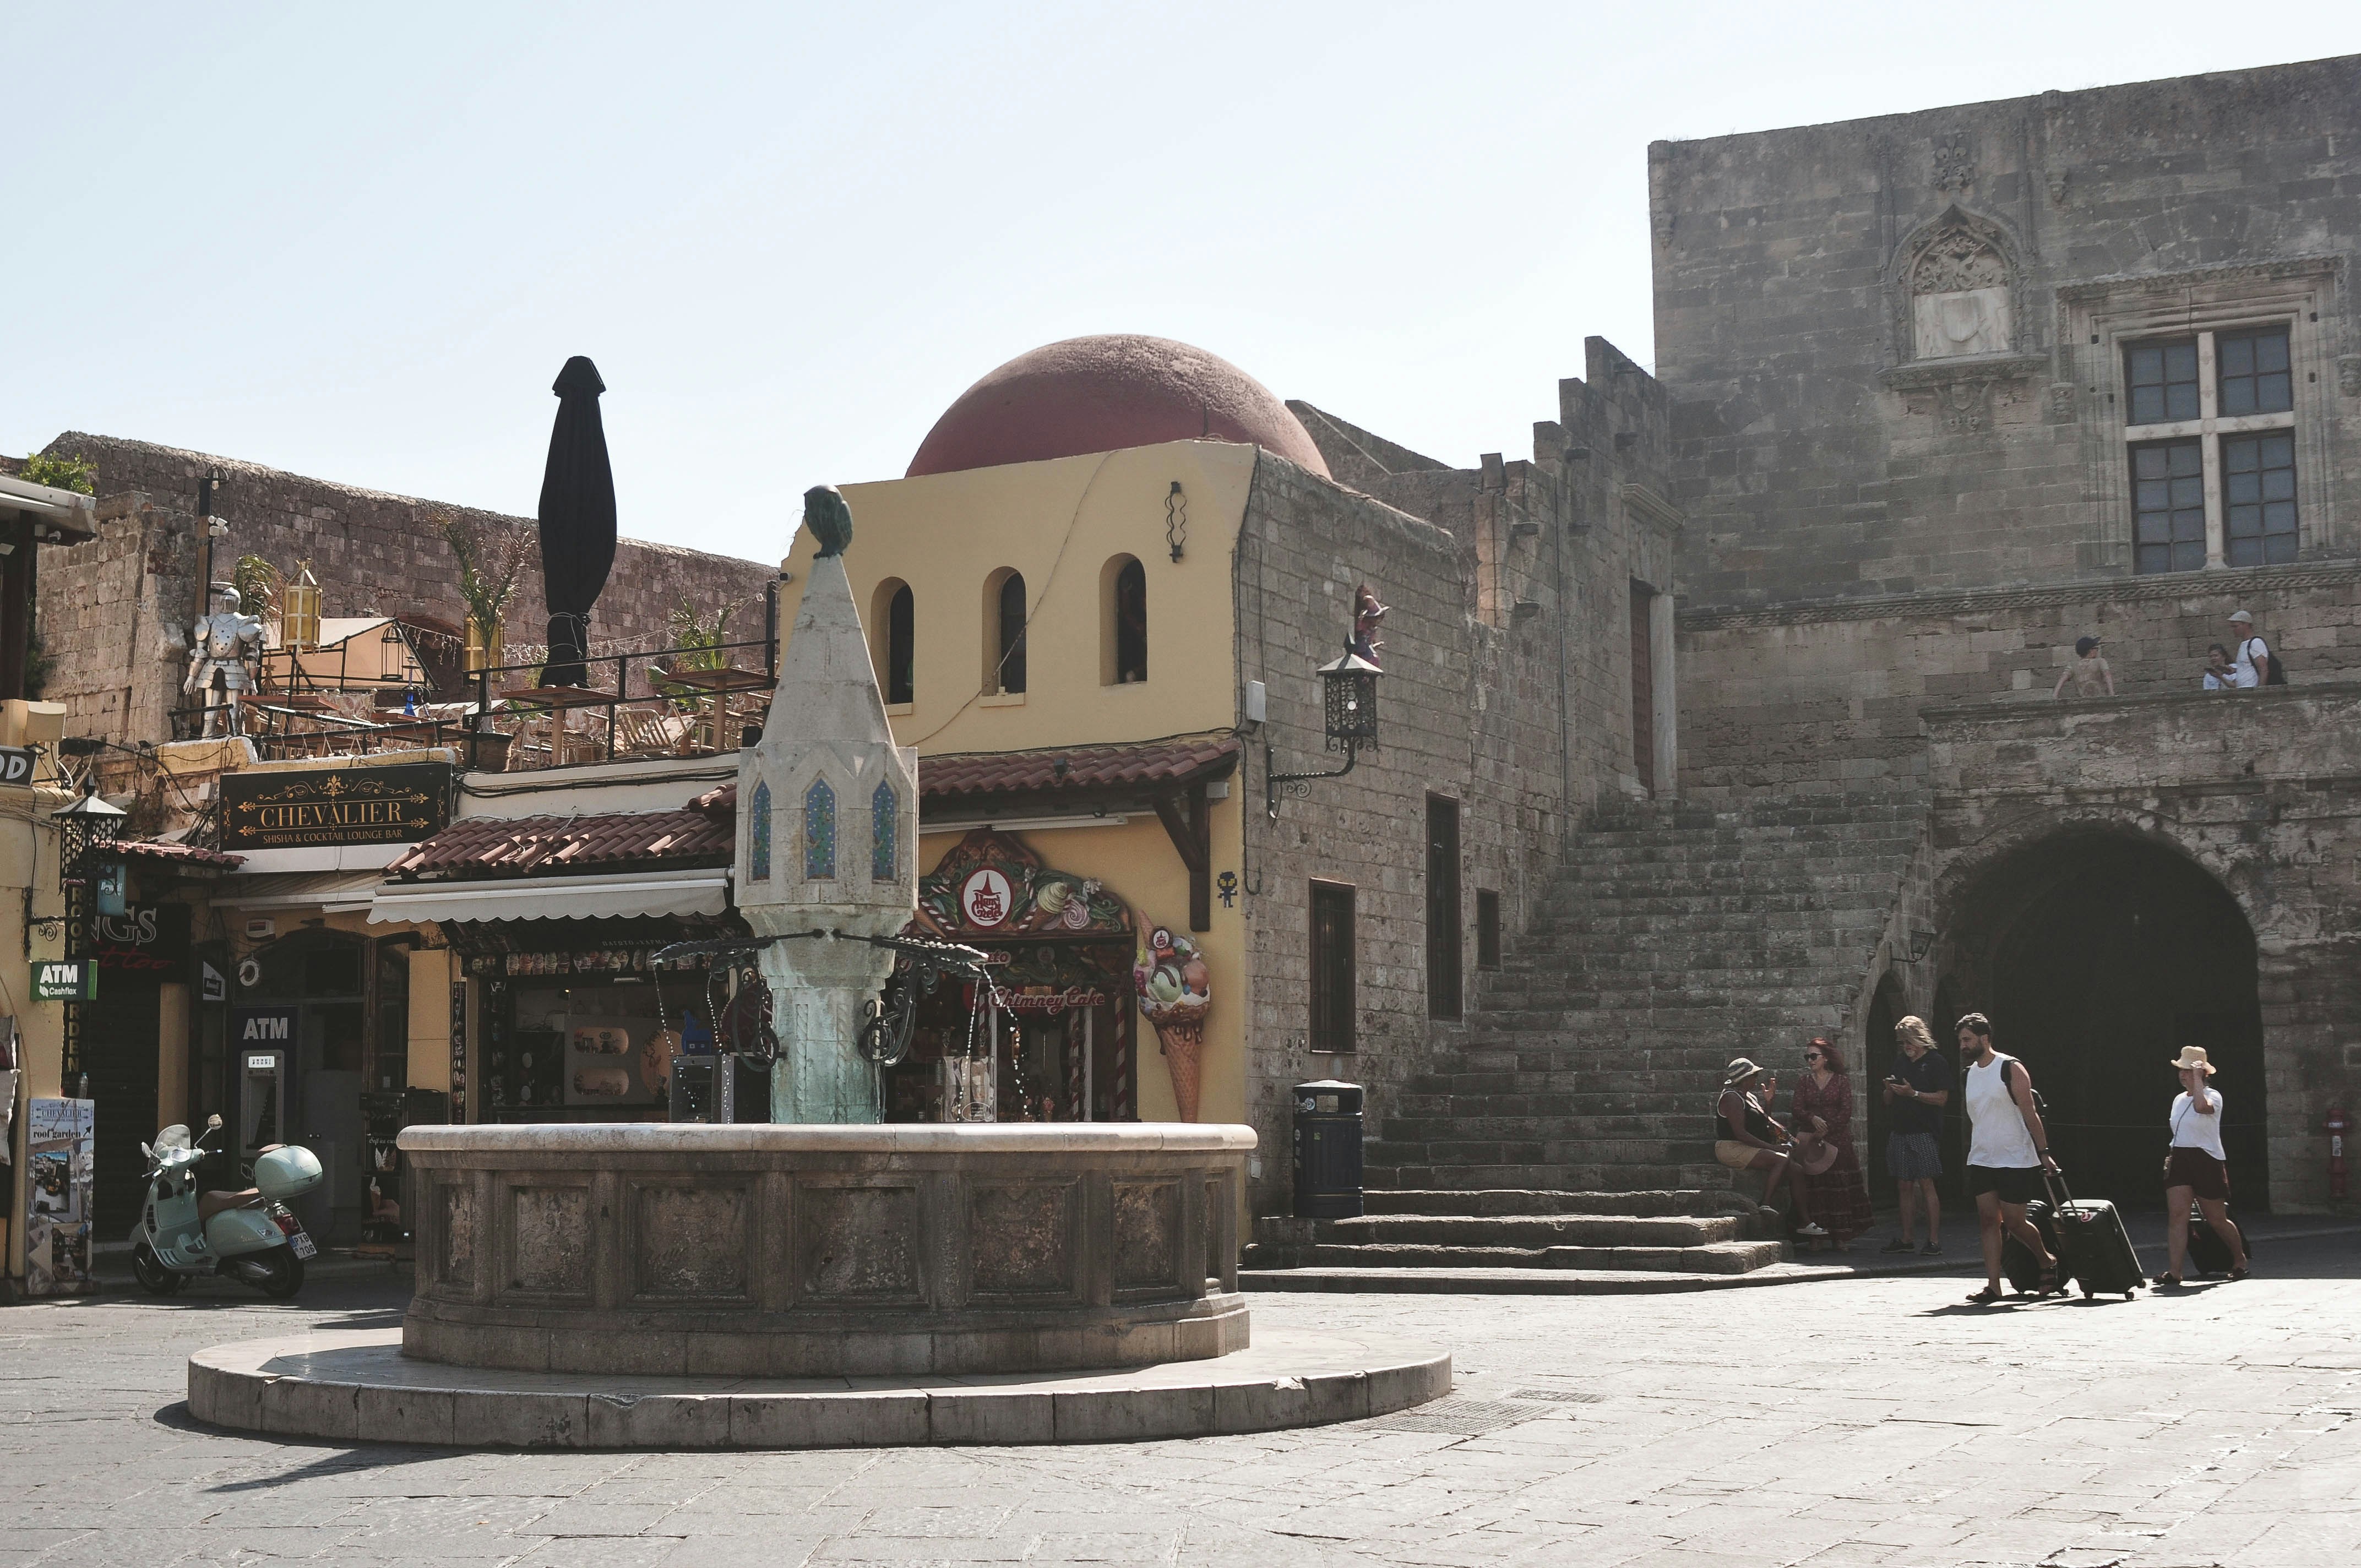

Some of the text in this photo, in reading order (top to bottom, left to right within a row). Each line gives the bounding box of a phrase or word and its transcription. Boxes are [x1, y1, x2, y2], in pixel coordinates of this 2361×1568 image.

[0, 753, 27, 779] D
[260, 802, 401, 827] CHEVALIER
[263, 829, 402, 844] SHISHA & COCKTAIL LOUNGE BAR
[70, 887, 84, 955] ROOF
[40, 965, 78, 984] ATM
[989, 986, 1105, 1015] Chimney Cake
[68, 1004, 80, 1072] RDEN
[243, 1017, 287, 1039] ATM
[34, 1129, 80, 1140] roof garden
[294, 1234, 309, 1245] PXB
[300, 1244, 314, 1255] 706
